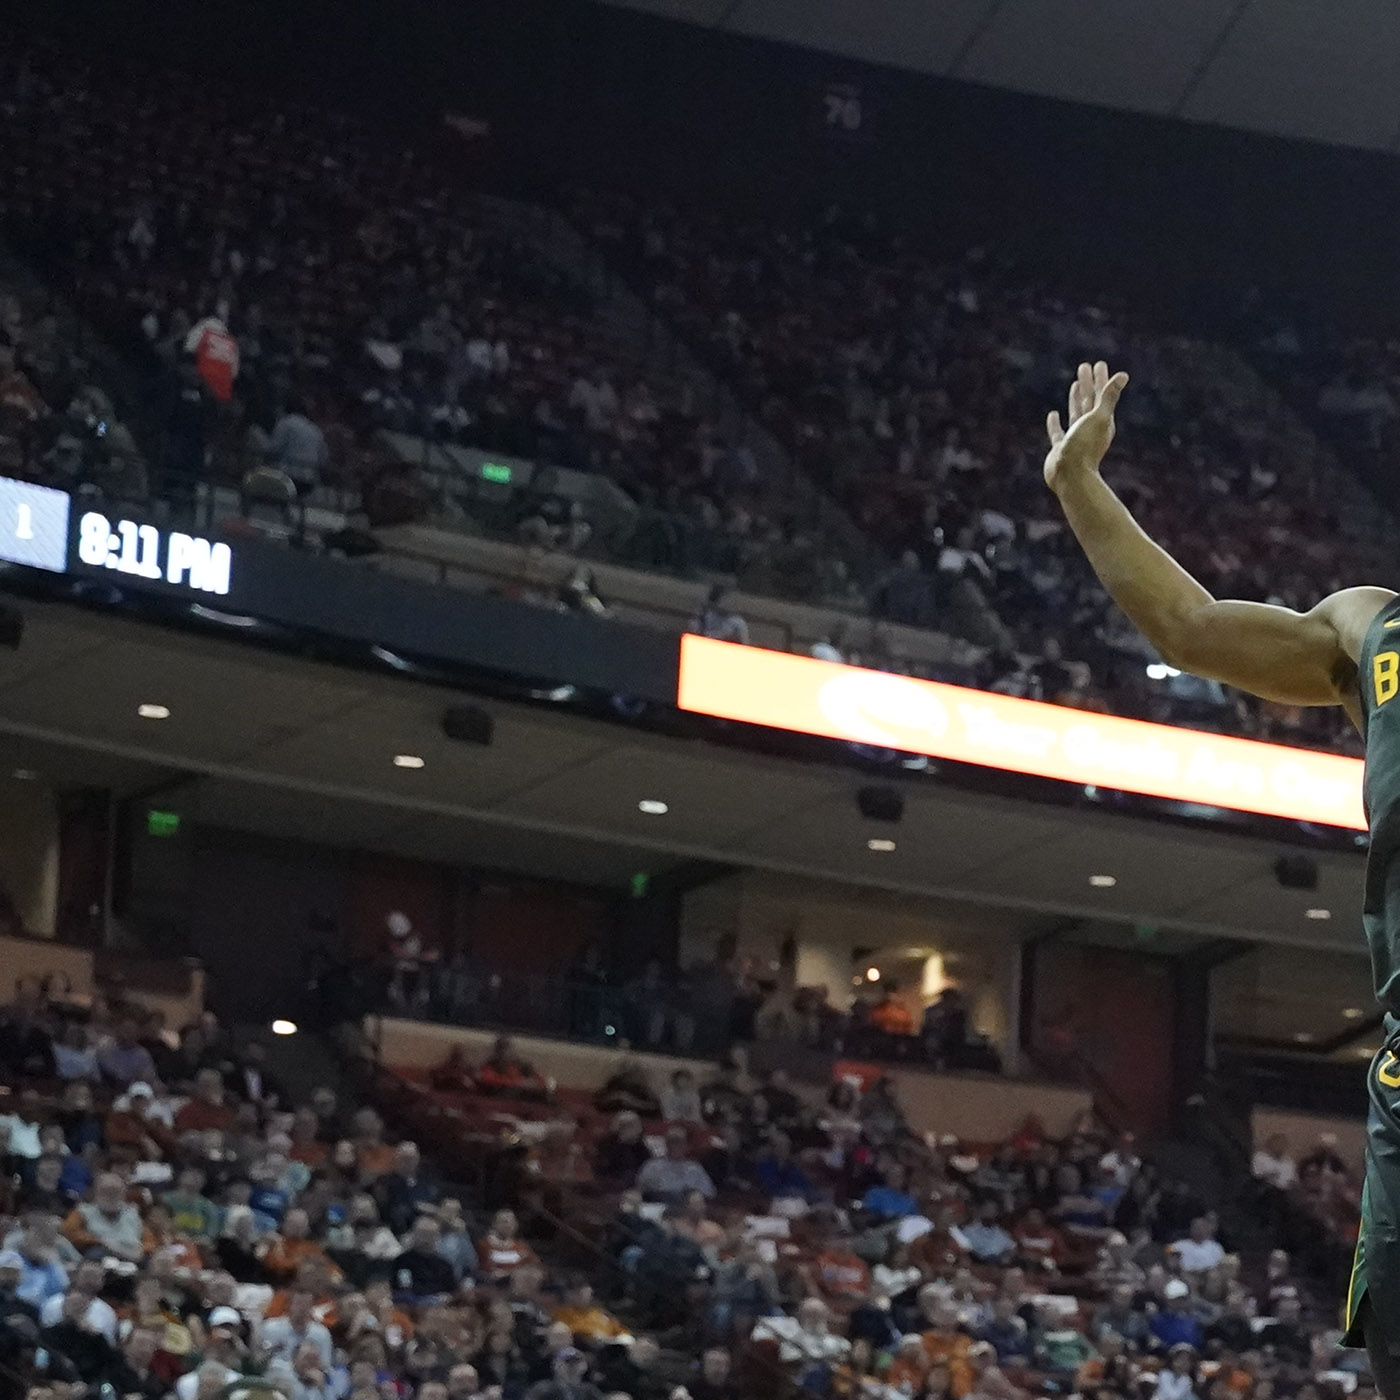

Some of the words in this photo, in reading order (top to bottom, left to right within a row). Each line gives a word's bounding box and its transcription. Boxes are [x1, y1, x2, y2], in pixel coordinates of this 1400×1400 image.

[15, 503, 34, 540] 1
[79, 511, 162, 580] 8:11
[167, 531, 232, 595] PM
